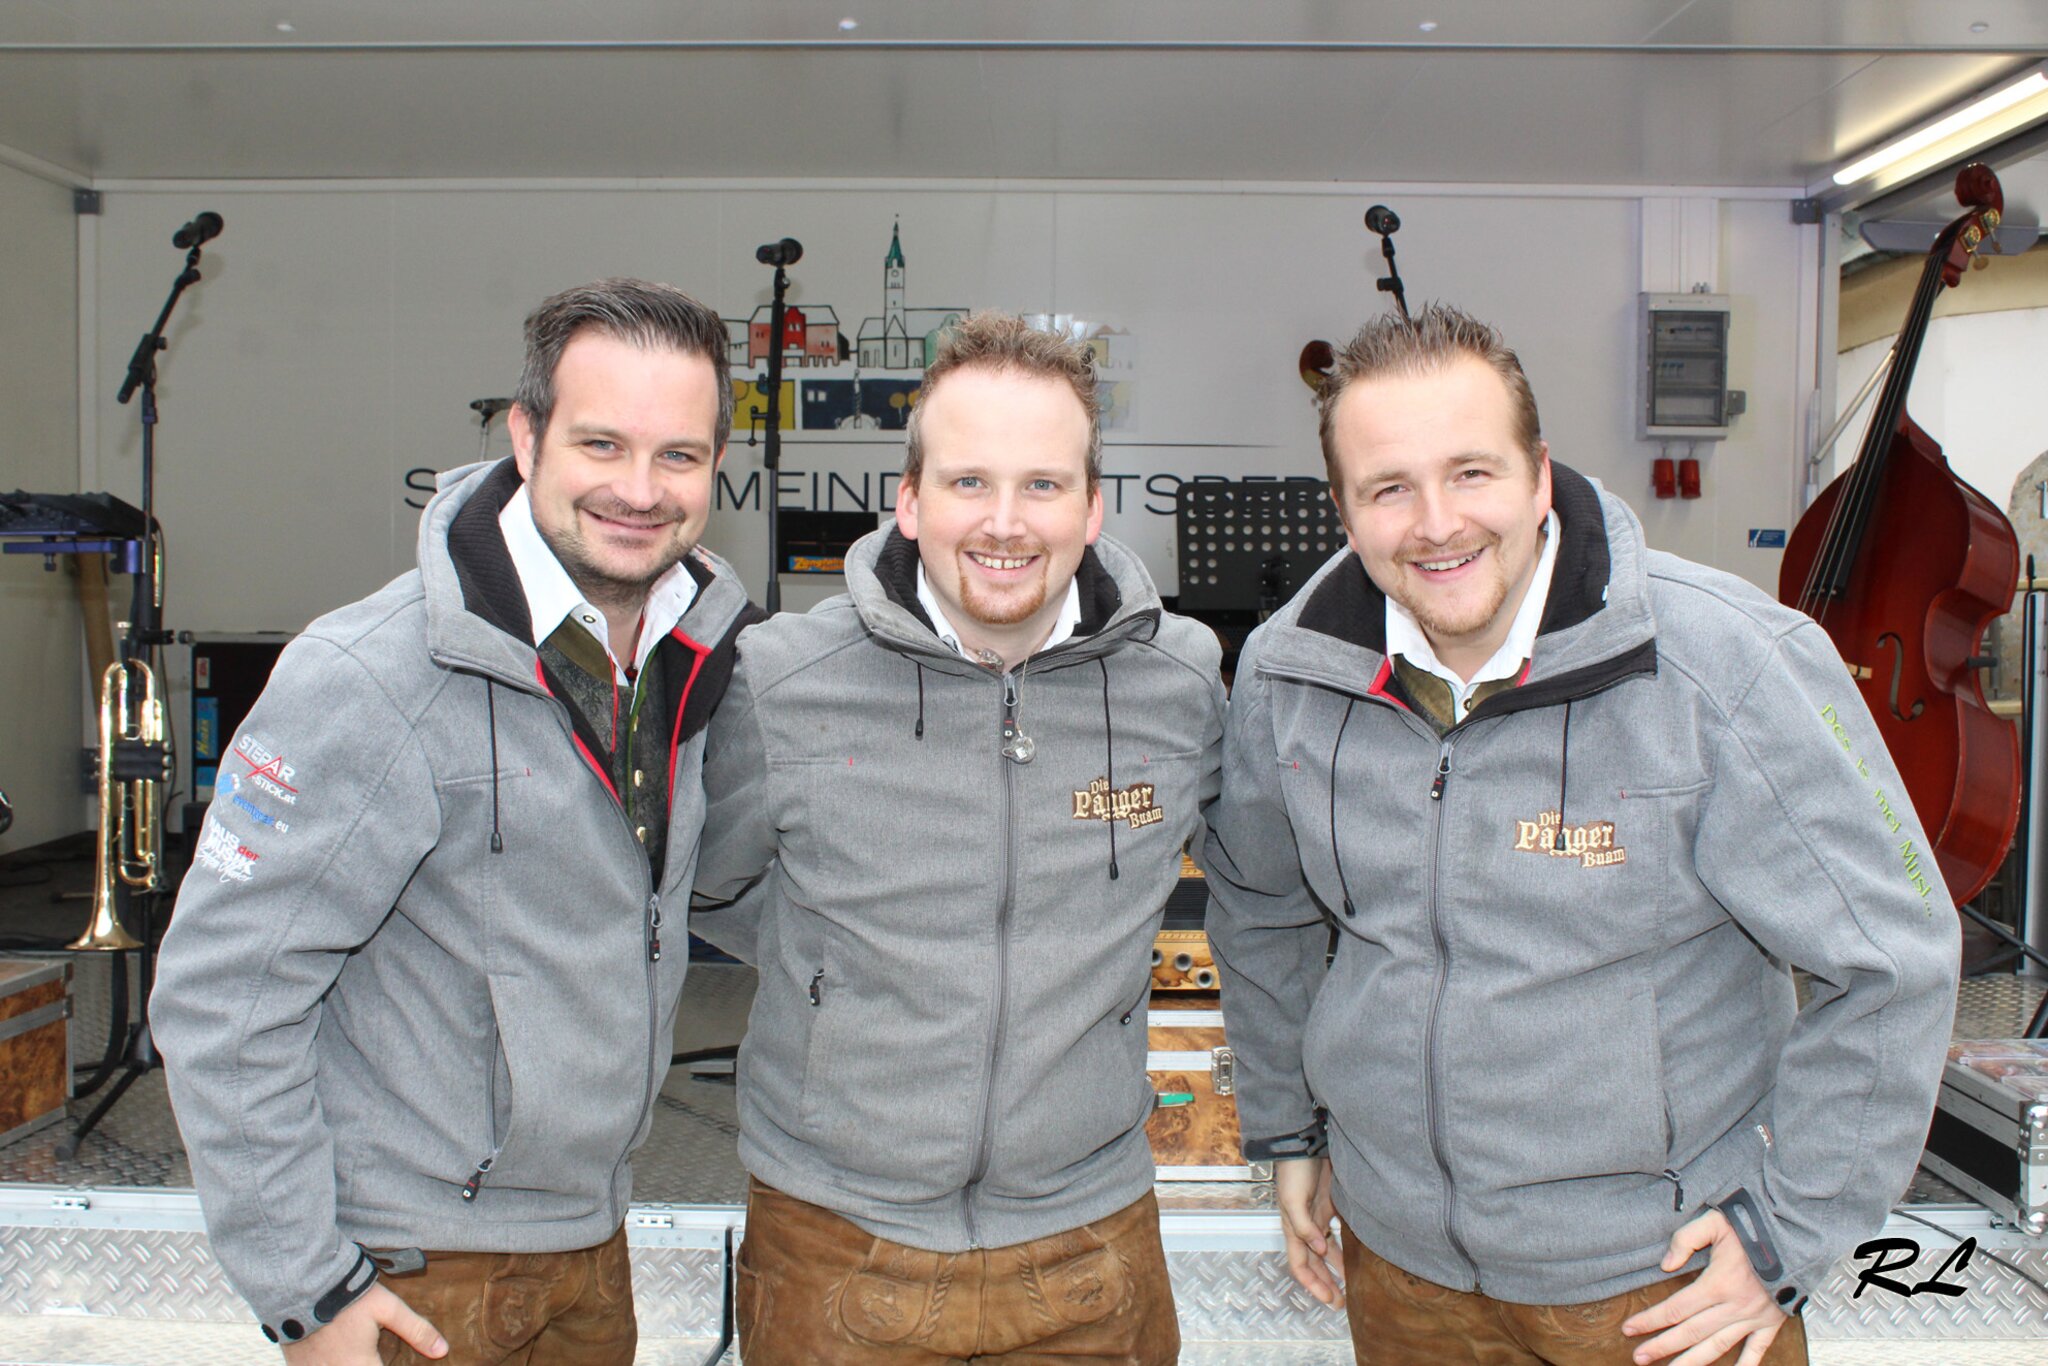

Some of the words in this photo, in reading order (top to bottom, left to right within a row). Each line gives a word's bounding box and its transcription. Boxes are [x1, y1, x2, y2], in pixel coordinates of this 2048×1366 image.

[239, 733, 295, 783] STEPAR
[1090, 778, 1109, 794] Die
[1129, 807, 1163, 829] Buam
[1538, 810, 1562, 826] Die
[237, 845, 260, 862] der
[1581, 847, 1625, 868] Buam
